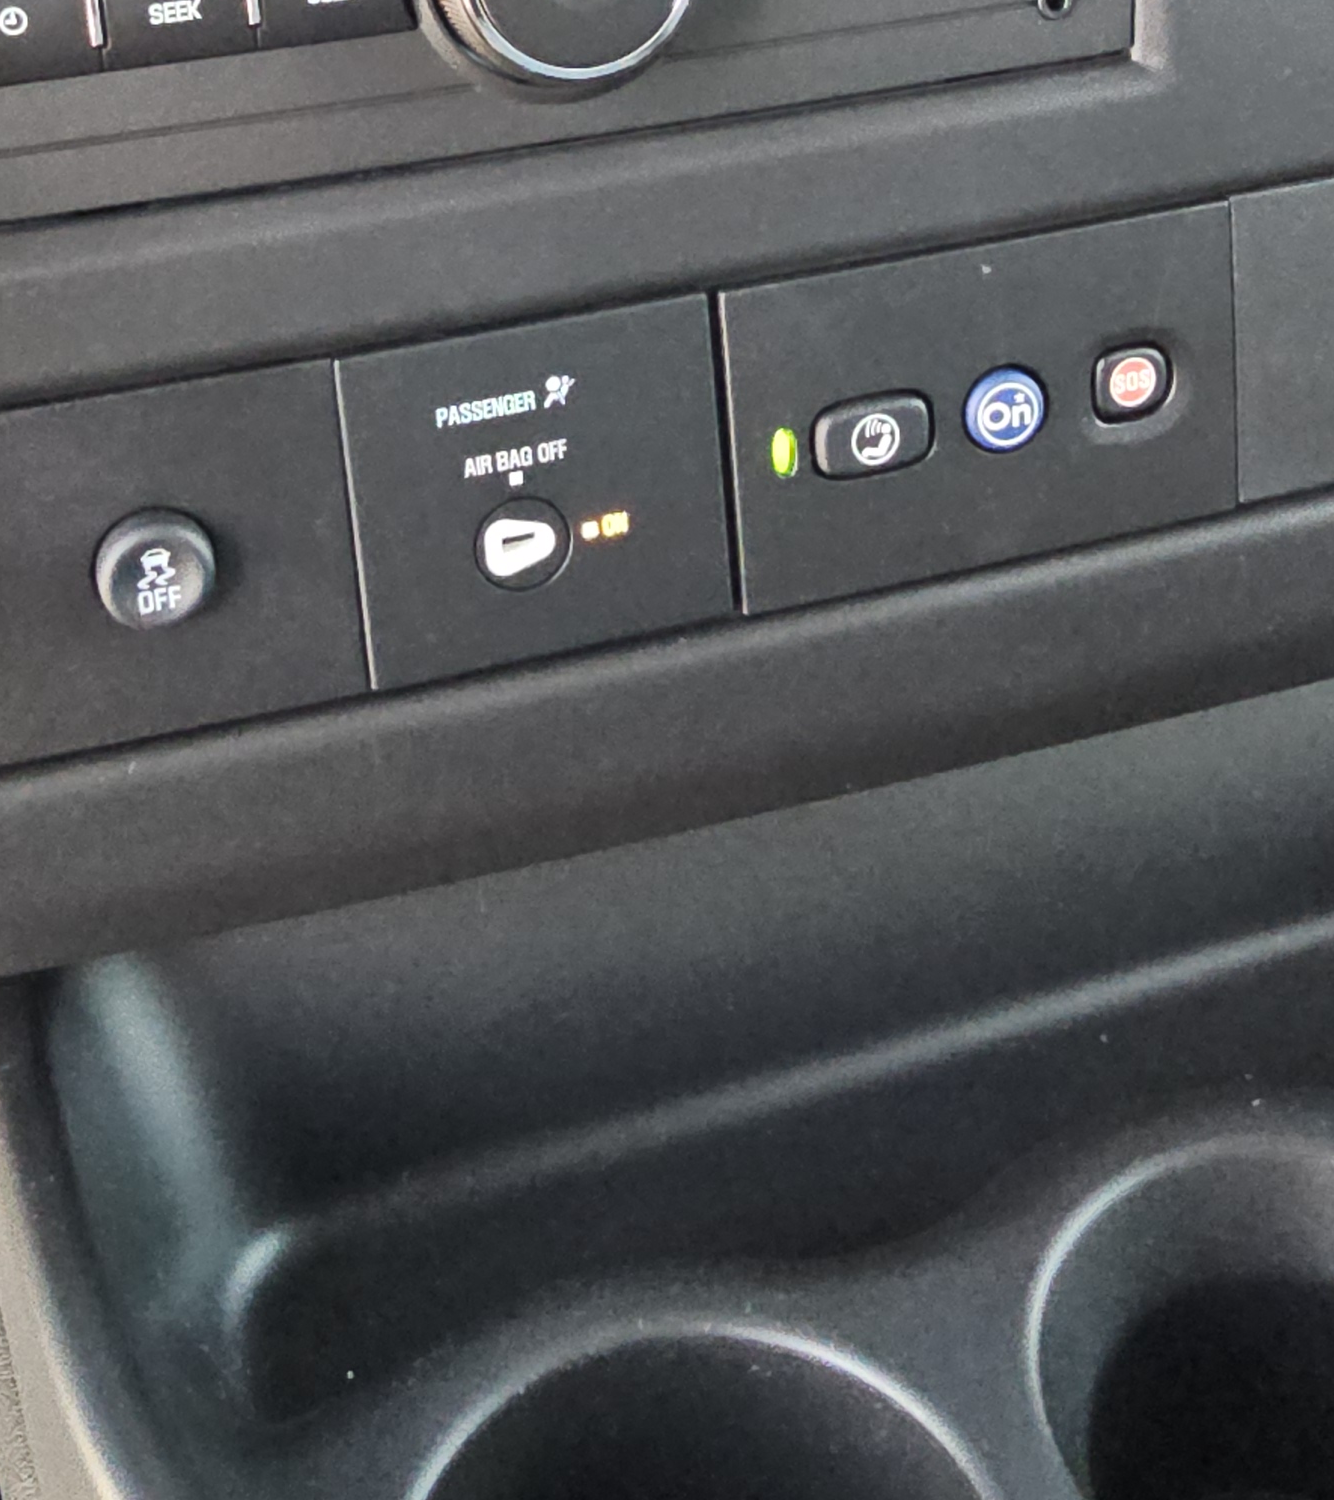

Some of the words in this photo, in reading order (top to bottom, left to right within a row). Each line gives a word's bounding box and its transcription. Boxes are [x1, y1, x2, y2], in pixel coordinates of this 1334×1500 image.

[148, 0, 202, 26] SEEK
[1113, 368, 1151, 395] SOS
[435, 390, 536, 429] PASSENGER
[464, 454, 493, 479] AIR
[495, 446, 533, 472] BAG
[537, 438, 568, 464] OFF
[600, 511, 630, 538] ON
[137, 585, 182, 616] OFF
